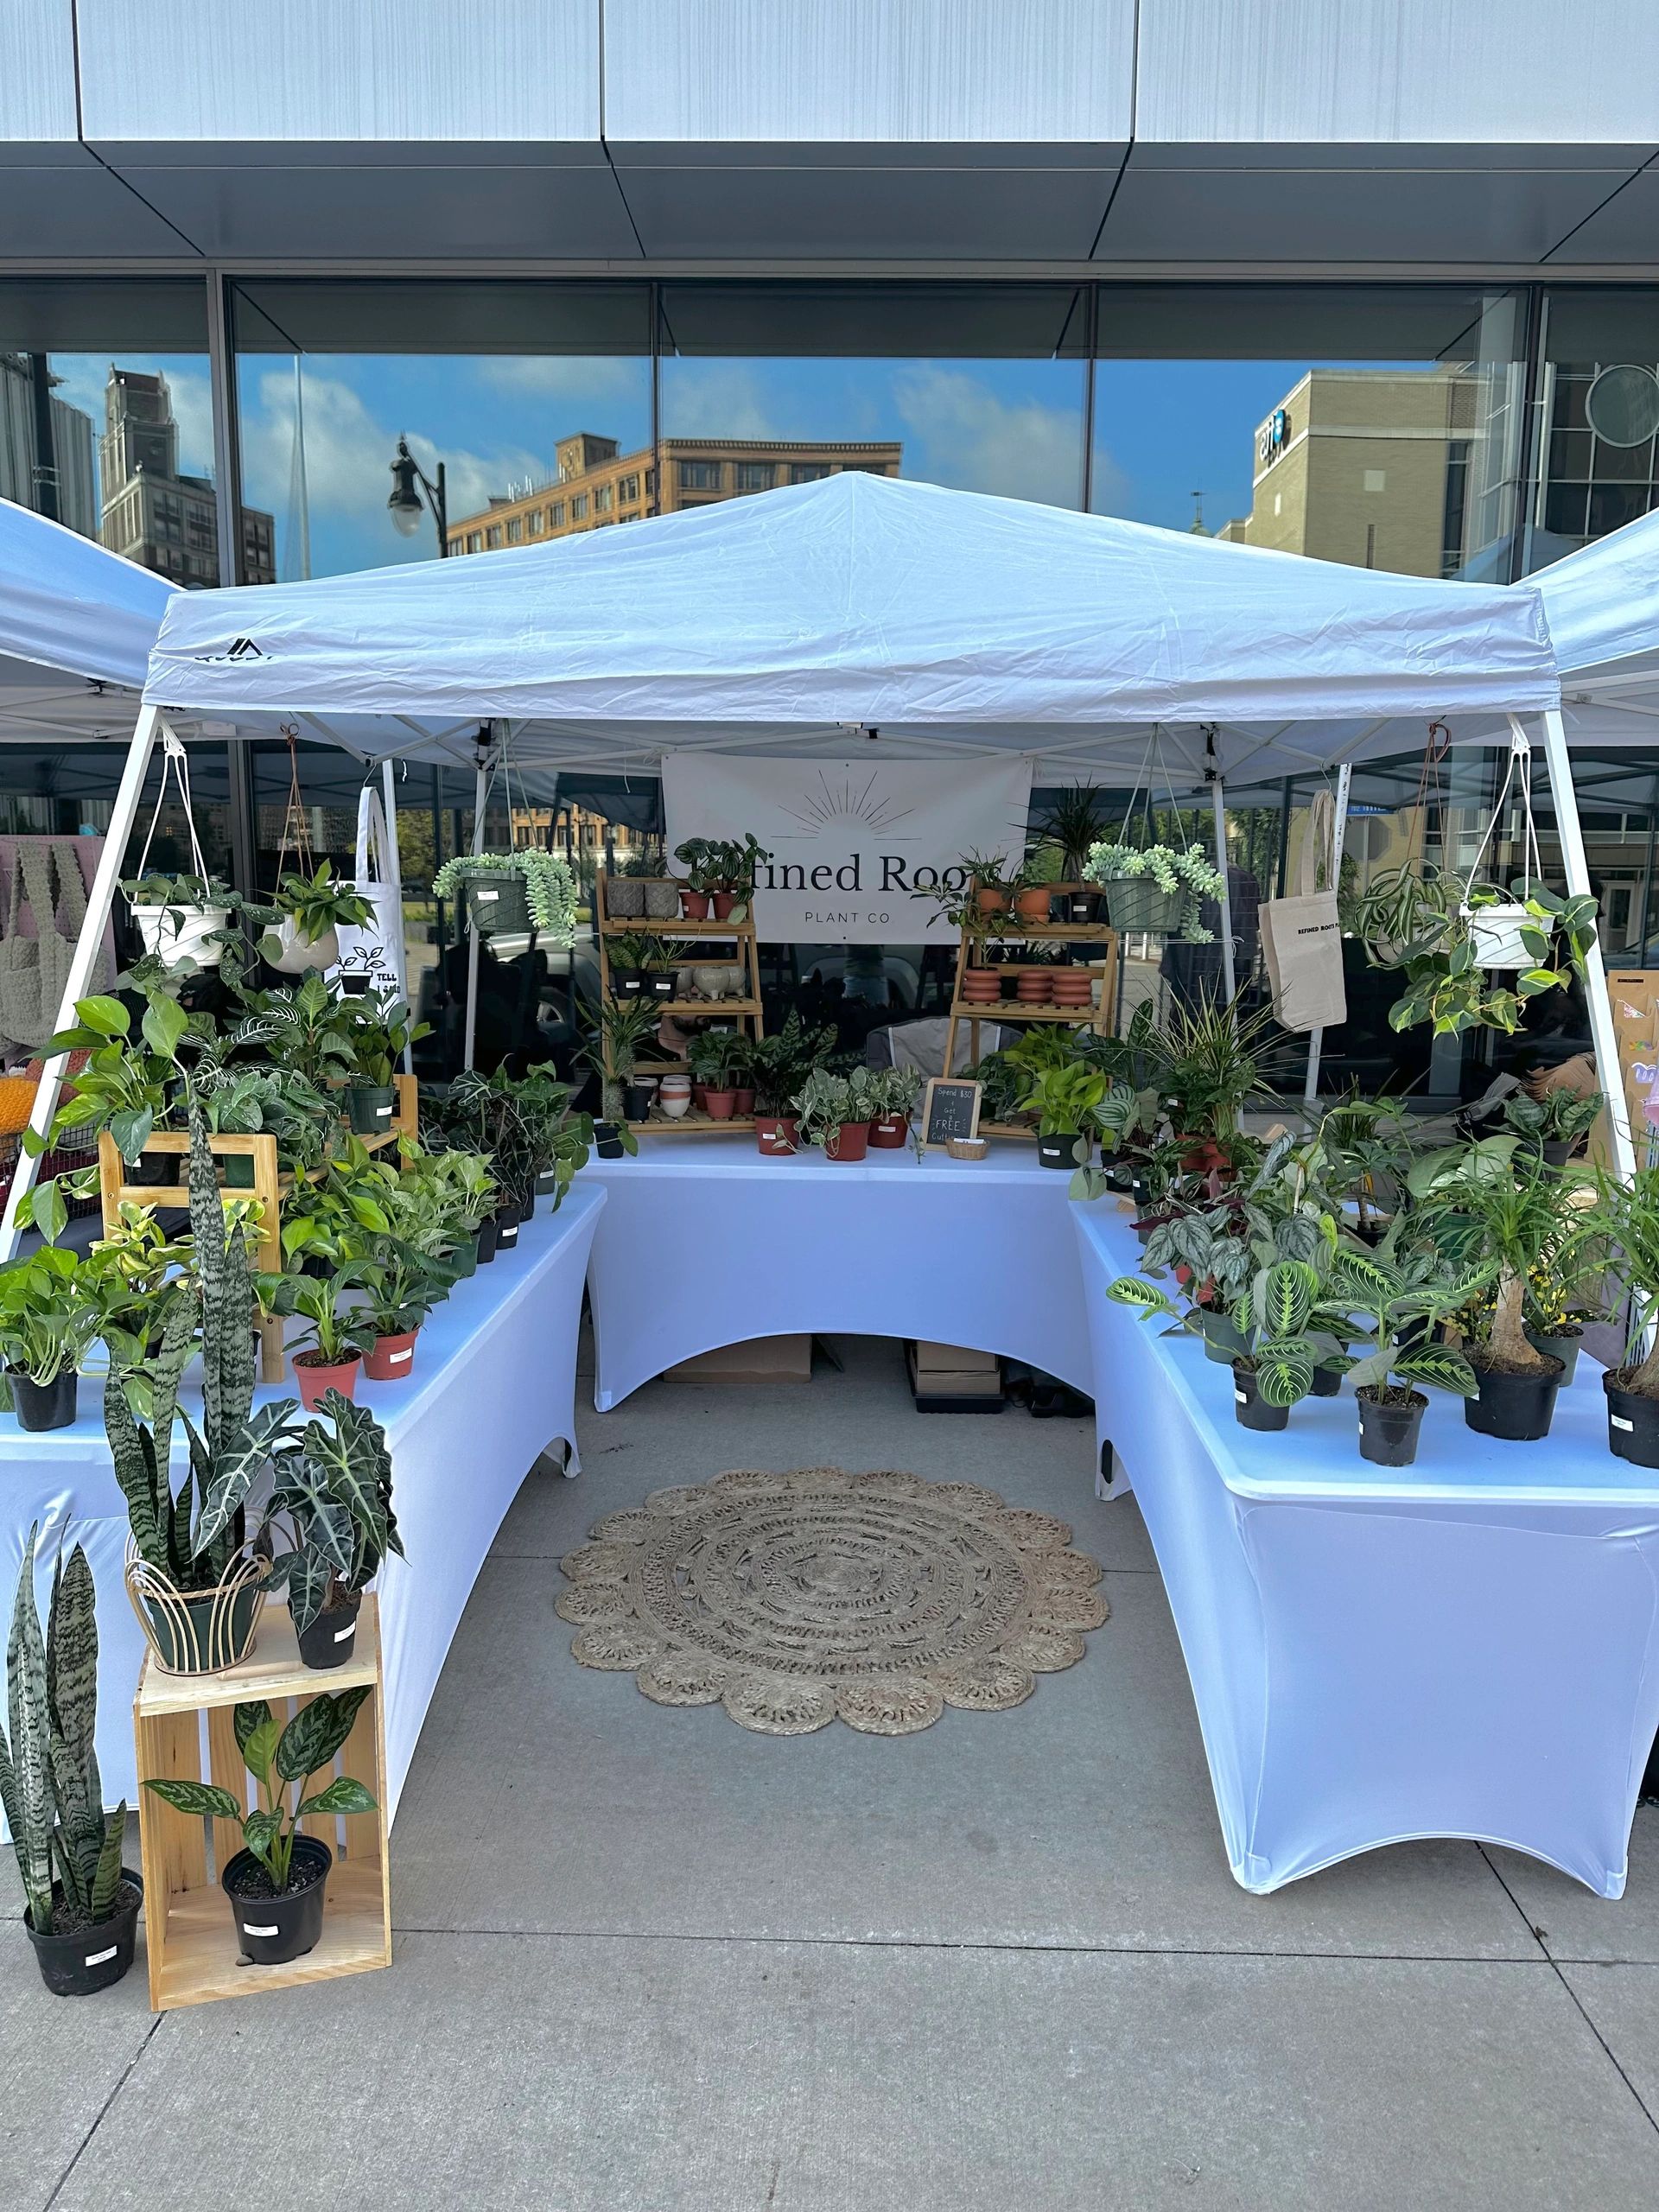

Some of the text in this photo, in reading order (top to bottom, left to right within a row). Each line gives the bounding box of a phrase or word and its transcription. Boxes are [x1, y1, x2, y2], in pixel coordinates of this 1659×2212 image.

[750, 852, 966, 892] fined Roo
[805, 912, 890, 924] PLANT CO
[1298, 926, 1319, 935] REFINED
[377, 973, 397, 982] TELL
[938, 1087, 973, 1098] Spend $30
[936, 1119, 961, 1131] FREE
